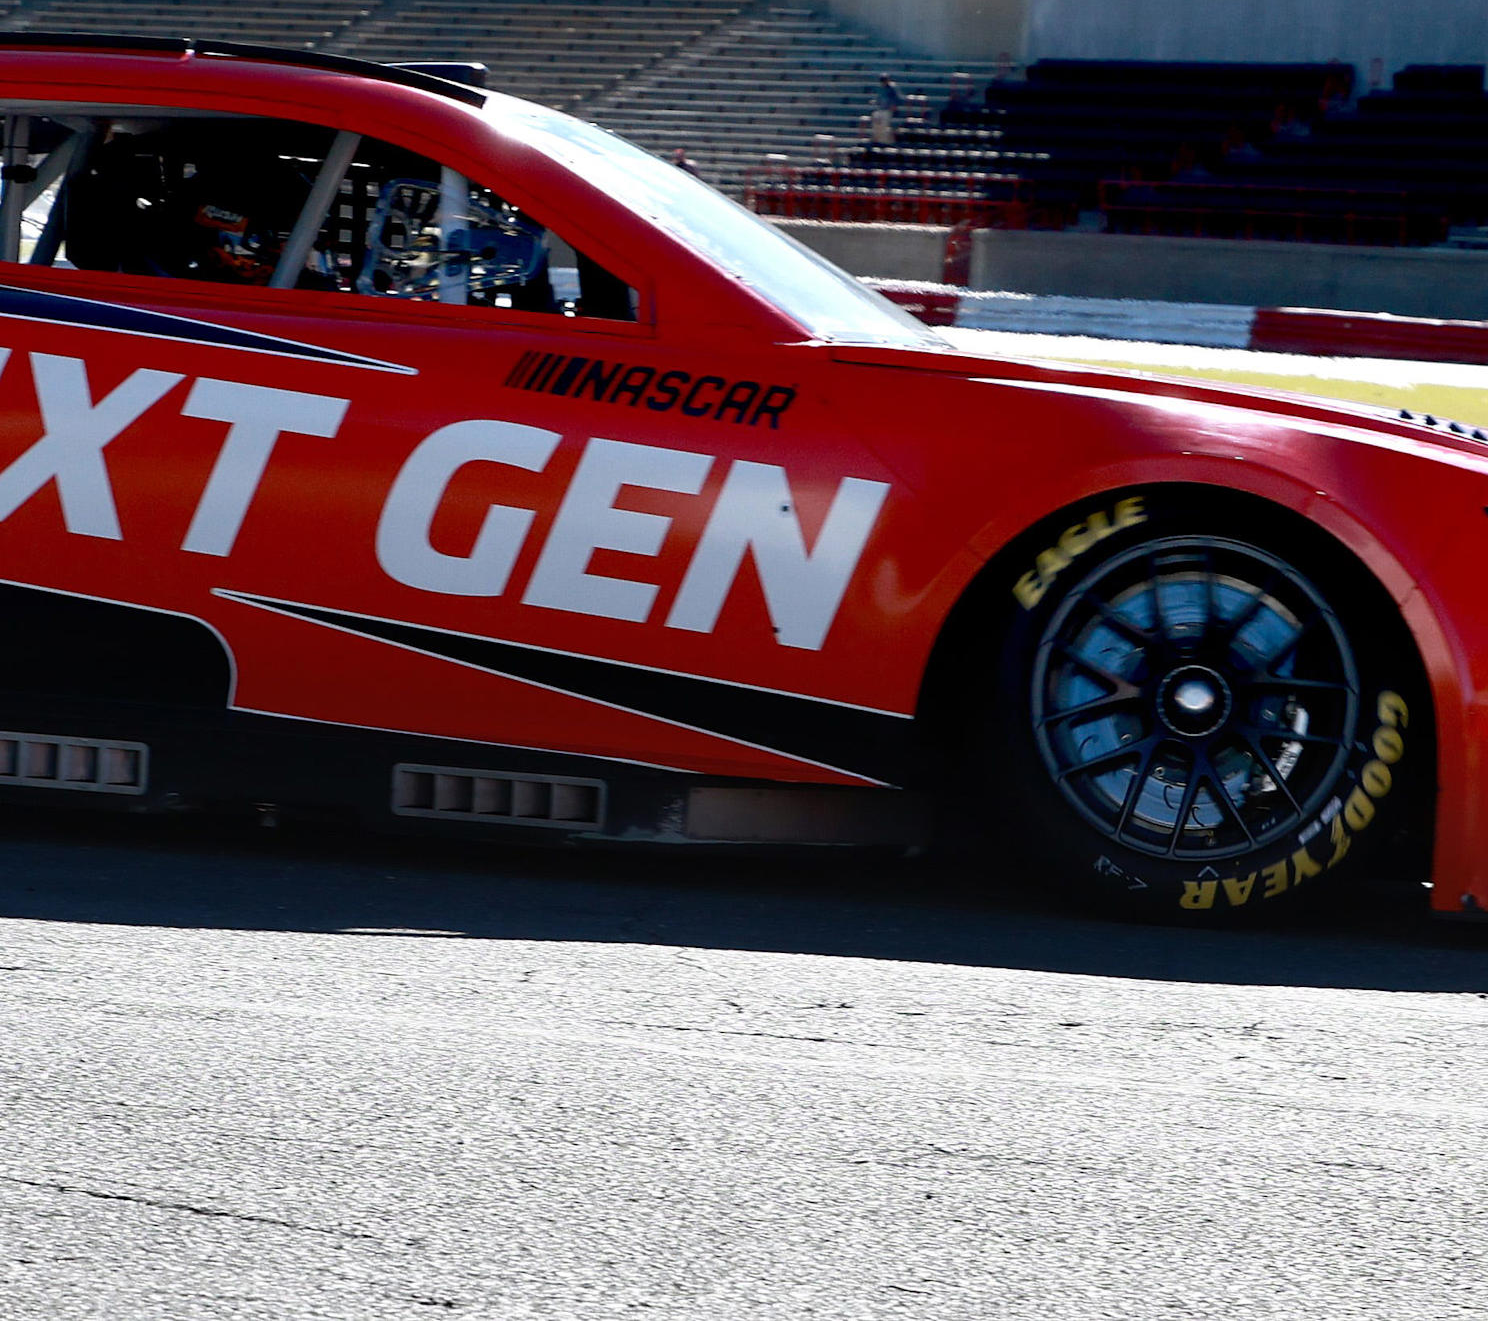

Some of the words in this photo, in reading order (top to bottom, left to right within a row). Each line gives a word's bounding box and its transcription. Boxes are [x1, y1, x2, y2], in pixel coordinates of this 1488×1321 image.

[570, 358, 797, 430] NASCAR
[375, 419, 892, 651] GEN
[1011, 495, 1148, 610] EAGLE
[1178, 690, 1410, 911] GOODYEAR
